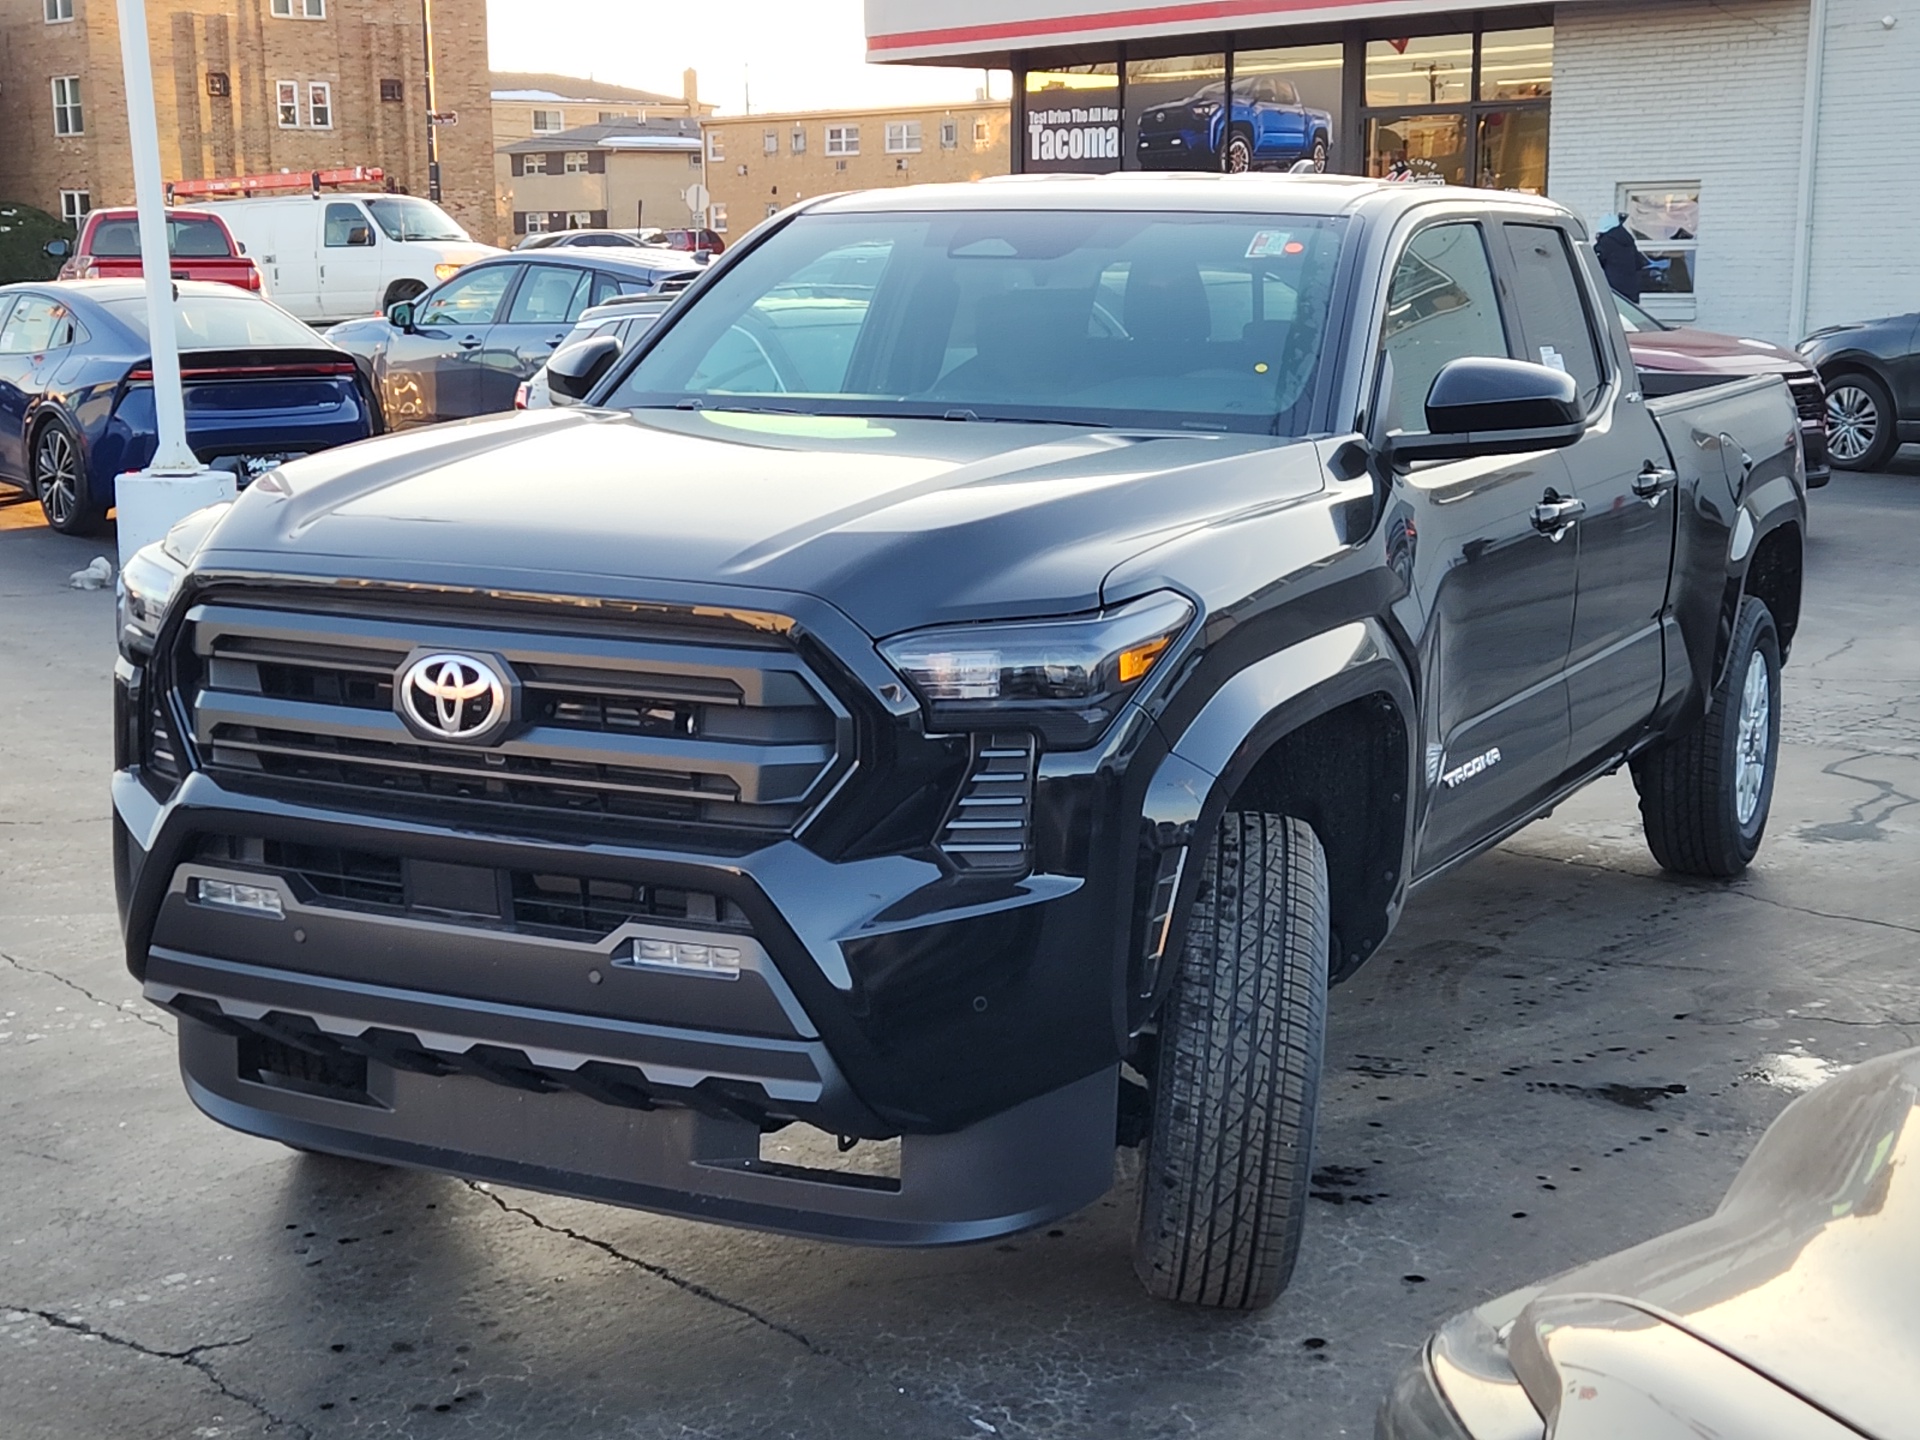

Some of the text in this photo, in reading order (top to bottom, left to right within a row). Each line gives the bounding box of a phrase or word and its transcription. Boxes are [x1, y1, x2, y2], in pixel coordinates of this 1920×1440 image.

[1028, 111, 1047, 125] Test
[1048, 109, 1071, 125] Drive
[1071, 108, 1088, 123] The
[1089, 107, 1101, 122] All
[1028, 124, 1119, 160] Tacoma
[1388, 158, 1438, 171] WELCOME
[1442, 747, 1502, 788] TACOMA
